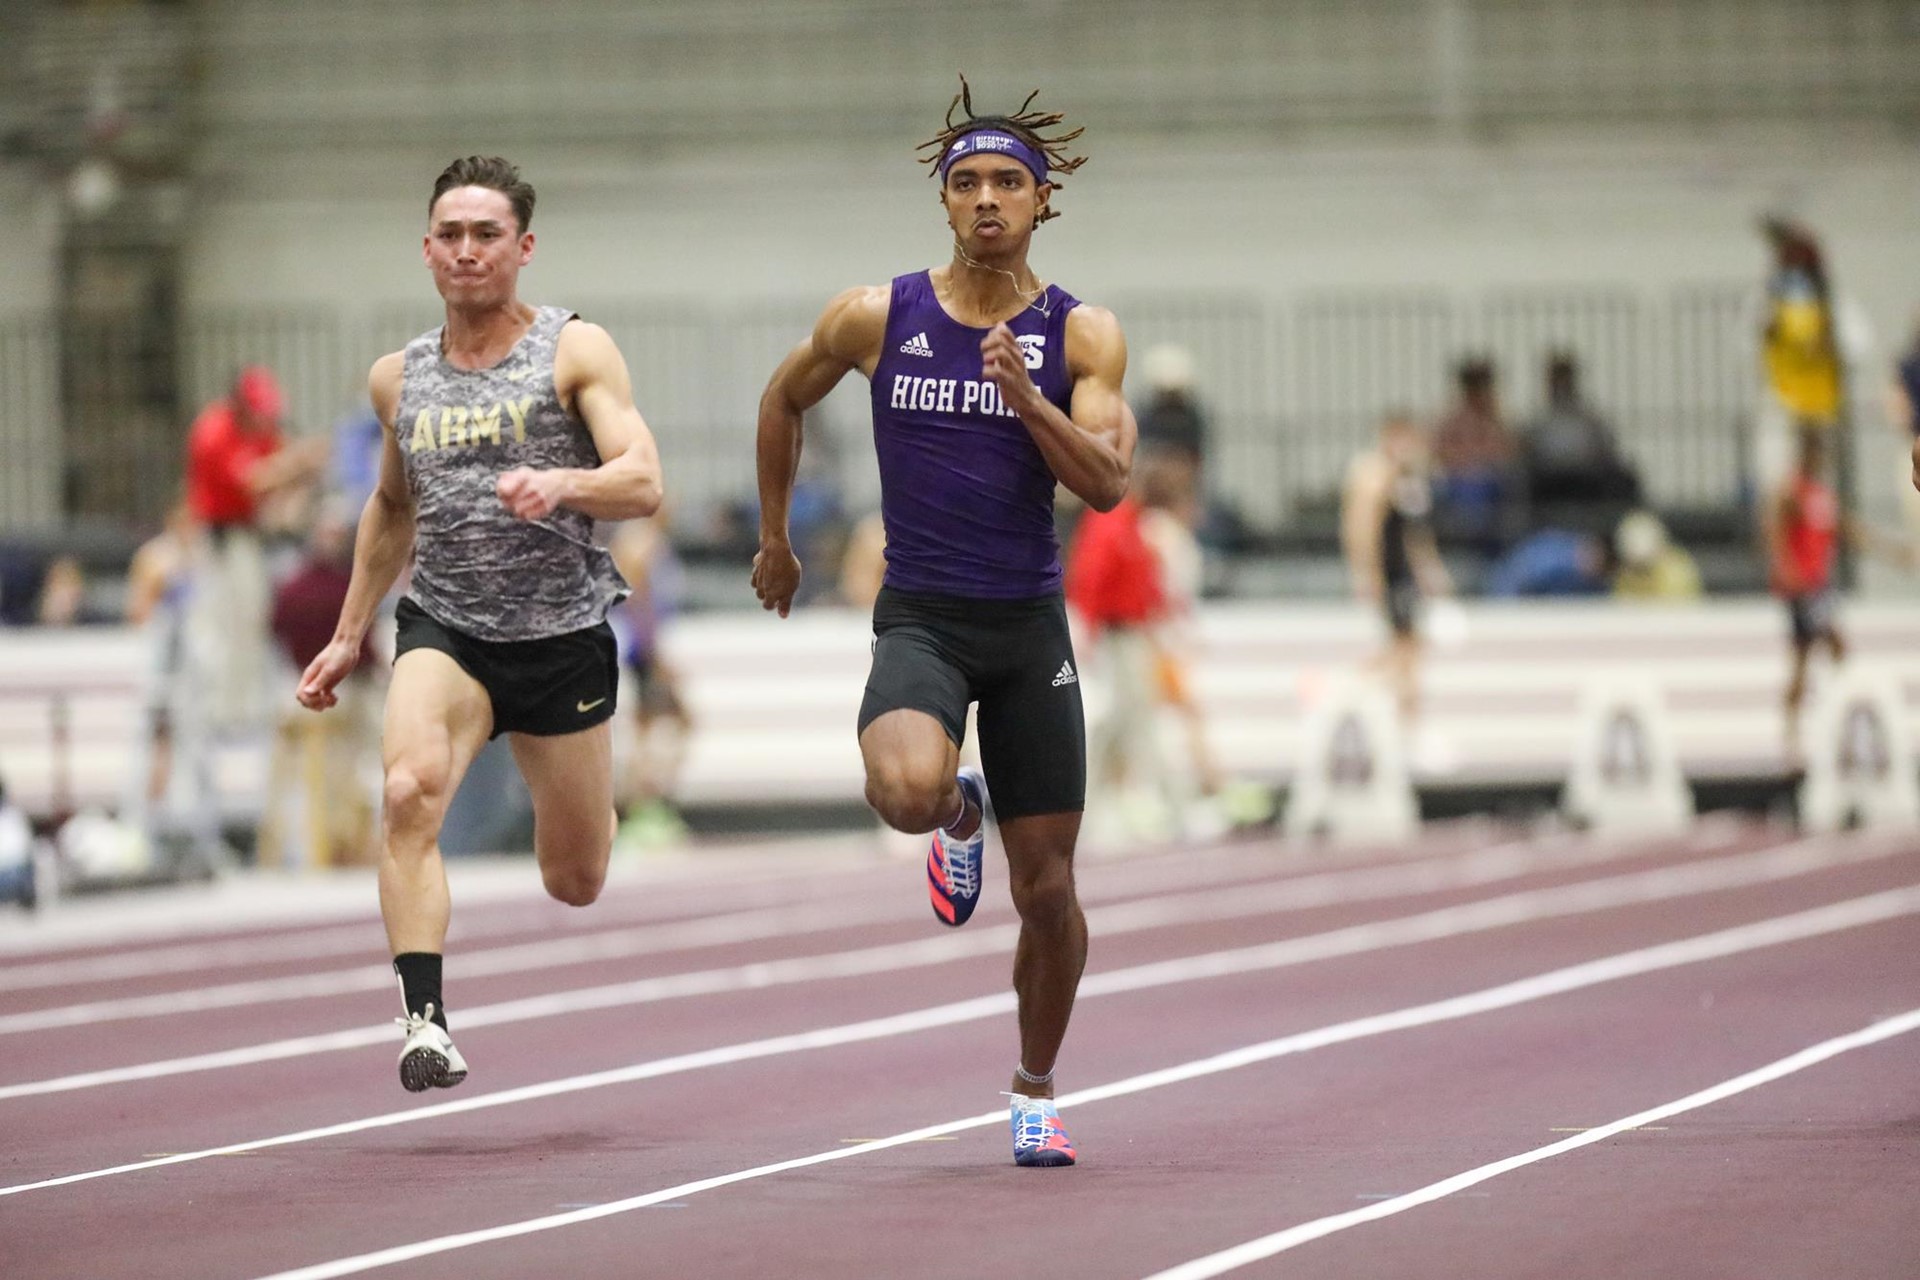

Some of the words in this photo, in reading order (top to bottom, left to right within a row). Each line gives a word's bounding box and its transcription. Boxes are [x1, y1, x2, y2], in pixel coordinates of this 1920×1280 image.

[900, 345, 933, 358] adidas
[891, 374, 957, 413] HIGH
[961, 380, 1042, 418] POI
[410, 396, 534, 453] ARMY
